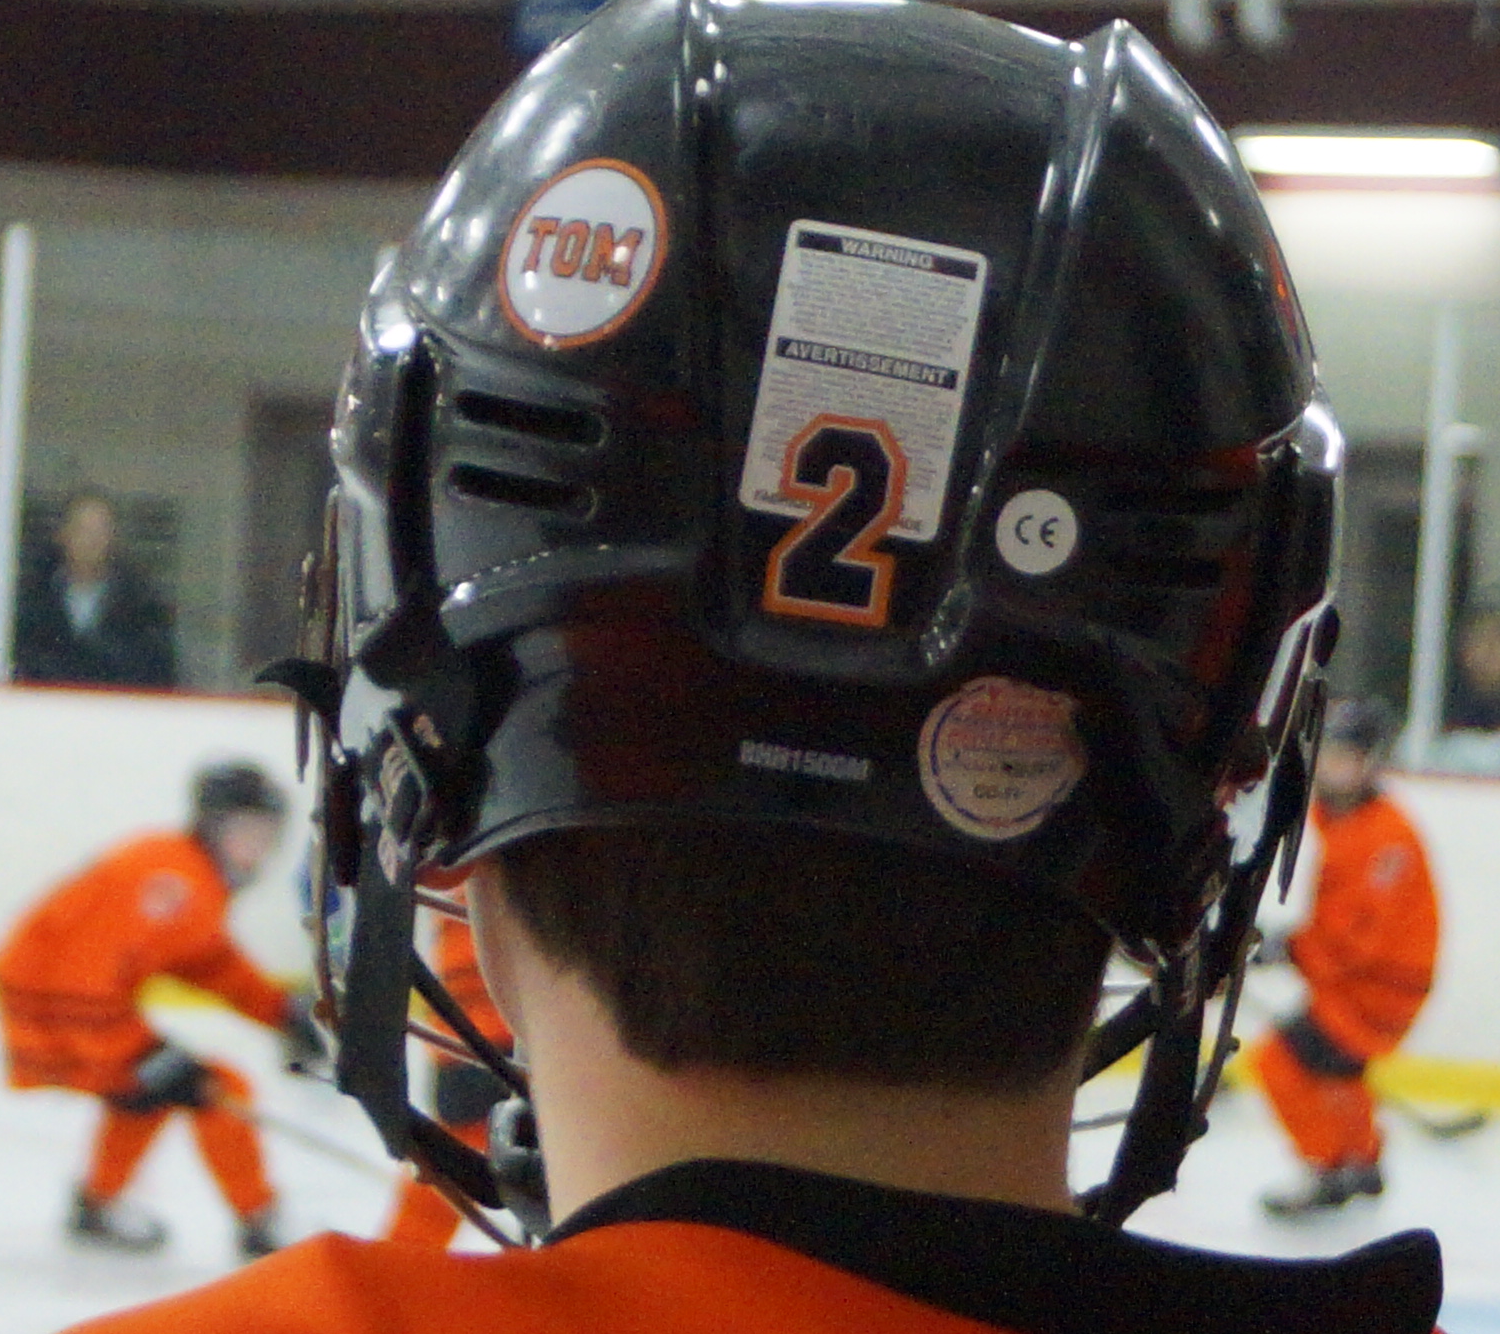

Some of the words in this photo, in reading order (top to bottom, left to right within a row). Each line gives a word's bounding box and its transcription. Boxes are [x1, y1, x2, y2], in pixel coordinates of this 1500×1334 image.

[523, 215, 645, 290] TOM
[841, 237, 934, 269] WARNING
[785, 339, 950, 386] AVERTISSEMENT
[762, 413, 908, 628] 2
